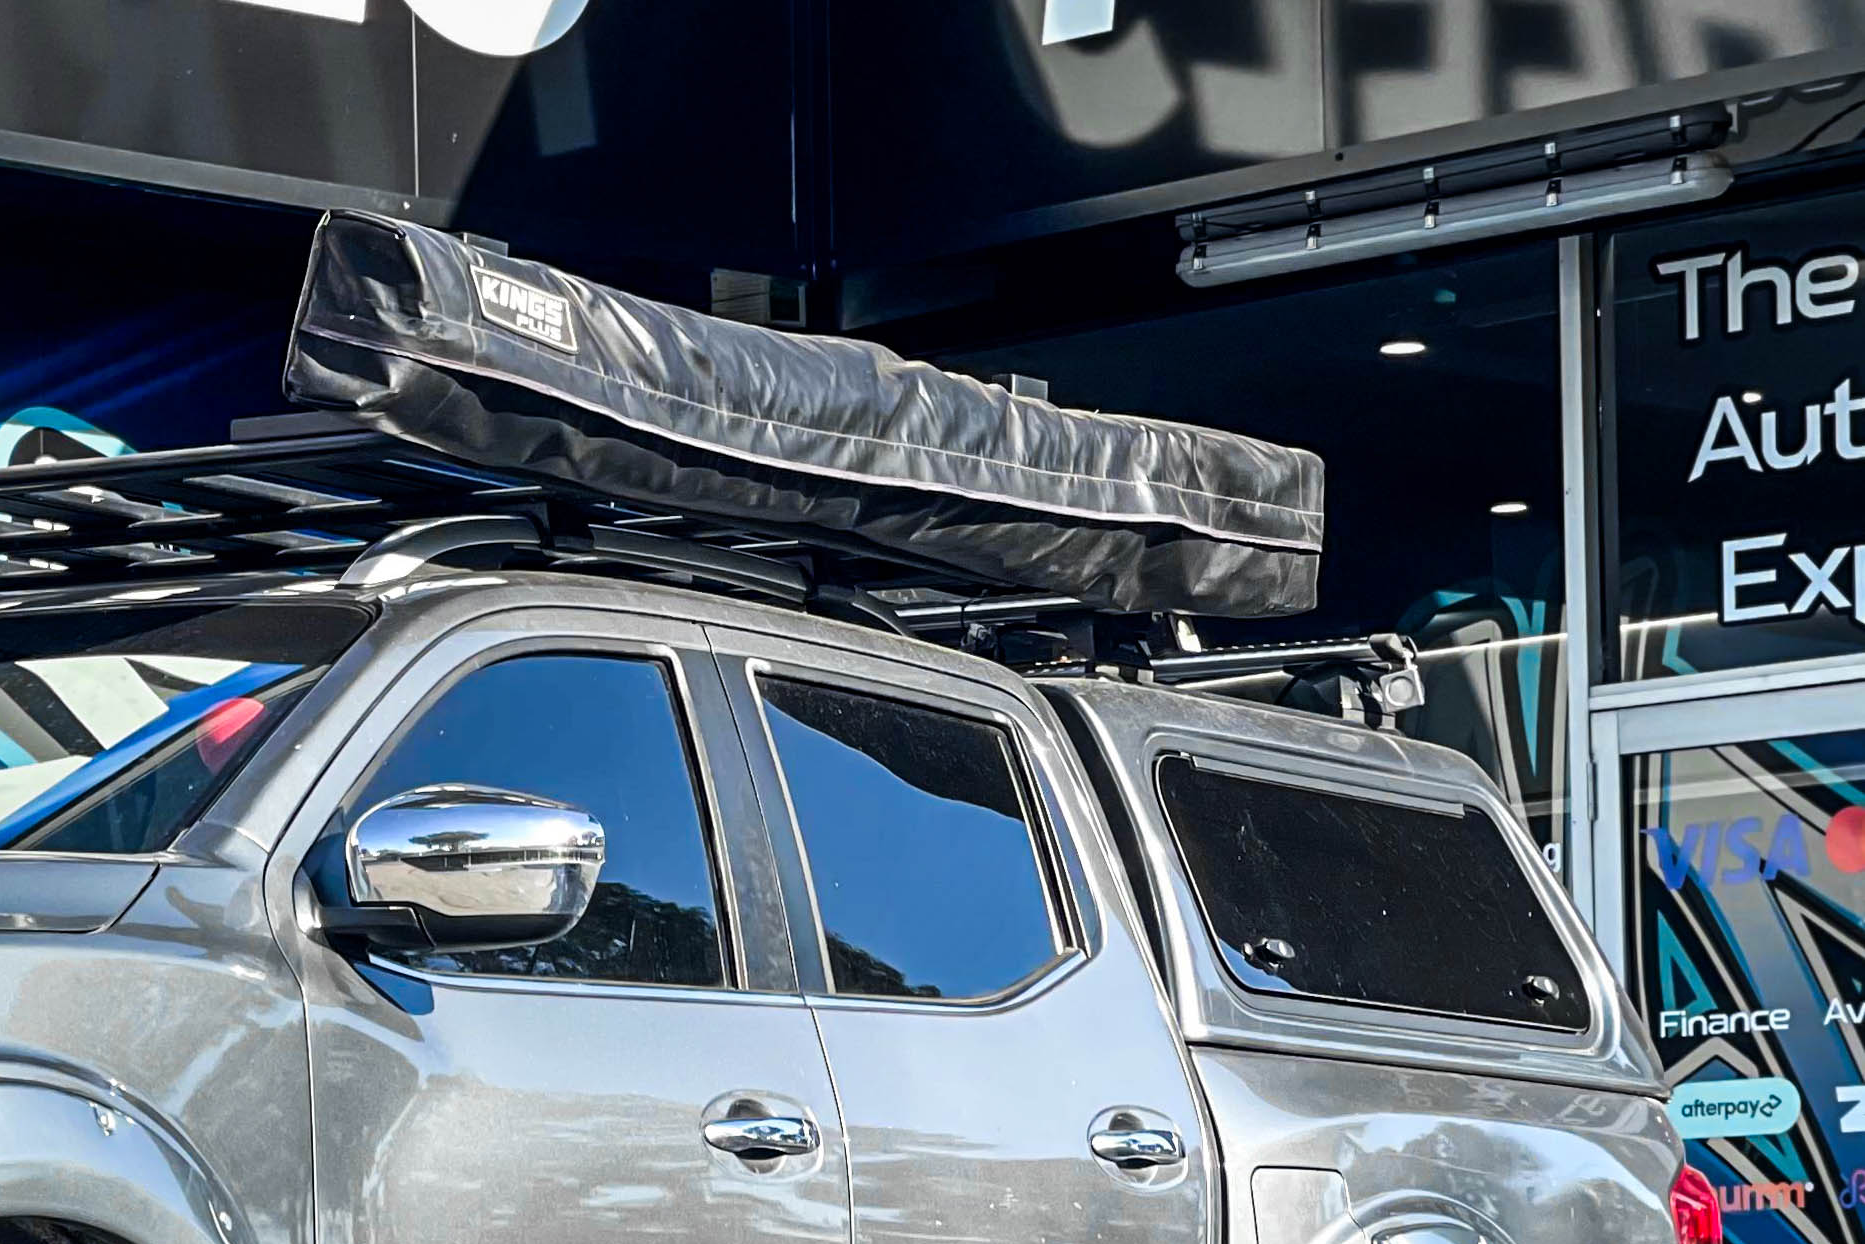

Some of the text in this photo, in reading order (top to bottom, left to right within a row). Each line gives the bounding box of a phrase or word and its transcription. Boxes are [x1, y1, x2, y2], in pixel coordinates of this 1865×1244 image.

[483, 275, 563, 327] KINGS
[1657, 250, 1859, 339] The
[517, 313, 562, 340] PLUS
[1688, 378, 1865, 483] Aut
[1723, 533, 1865, 624] Ex
[1639, 813, 1812, 890] VISA
[1660, 997, 1865, 1039] Finance Av
[1681, 1097, 1761, 1121] afterpay
[1719, 1182, 1806, 1212] umm
